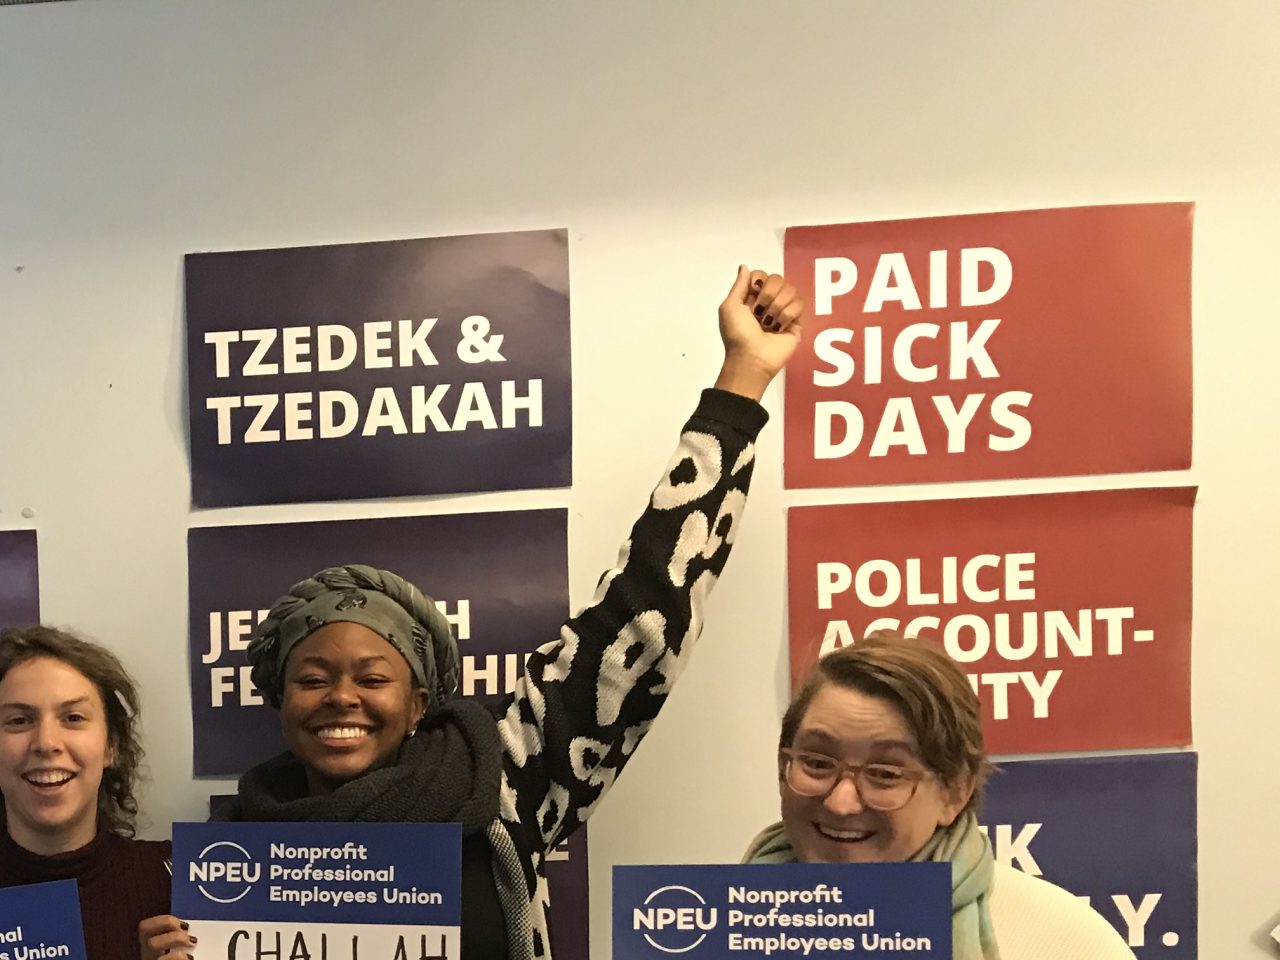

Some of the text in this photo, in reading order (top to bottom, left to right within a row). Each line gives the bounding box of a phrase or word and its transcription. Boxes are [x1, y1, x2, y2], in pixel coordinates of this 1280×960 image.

[814, 247, 1013, 316] PAID
[204, 315, 507, 378] TZEDEK &
[813, 318, 1002, 387] SICK
[206, 379, 543, 445] TZEDAKAH
[814, 391, 1033, 460] DAYS
[817, 552, 1036, 609] POLICE
[270, 842, 367, 863] Nonprofit
[189, 861, 261, 883] NPEU
[270, 864, 394, 882] Professional
[270, 885, 442, 907] Employees Union
[728, 884, 842, 907] Nonprofit
[633, 907, 717, 930] NPEU
[728, 908, 874, 927] Professional
[728, 932, 931, 955] Employees Union
